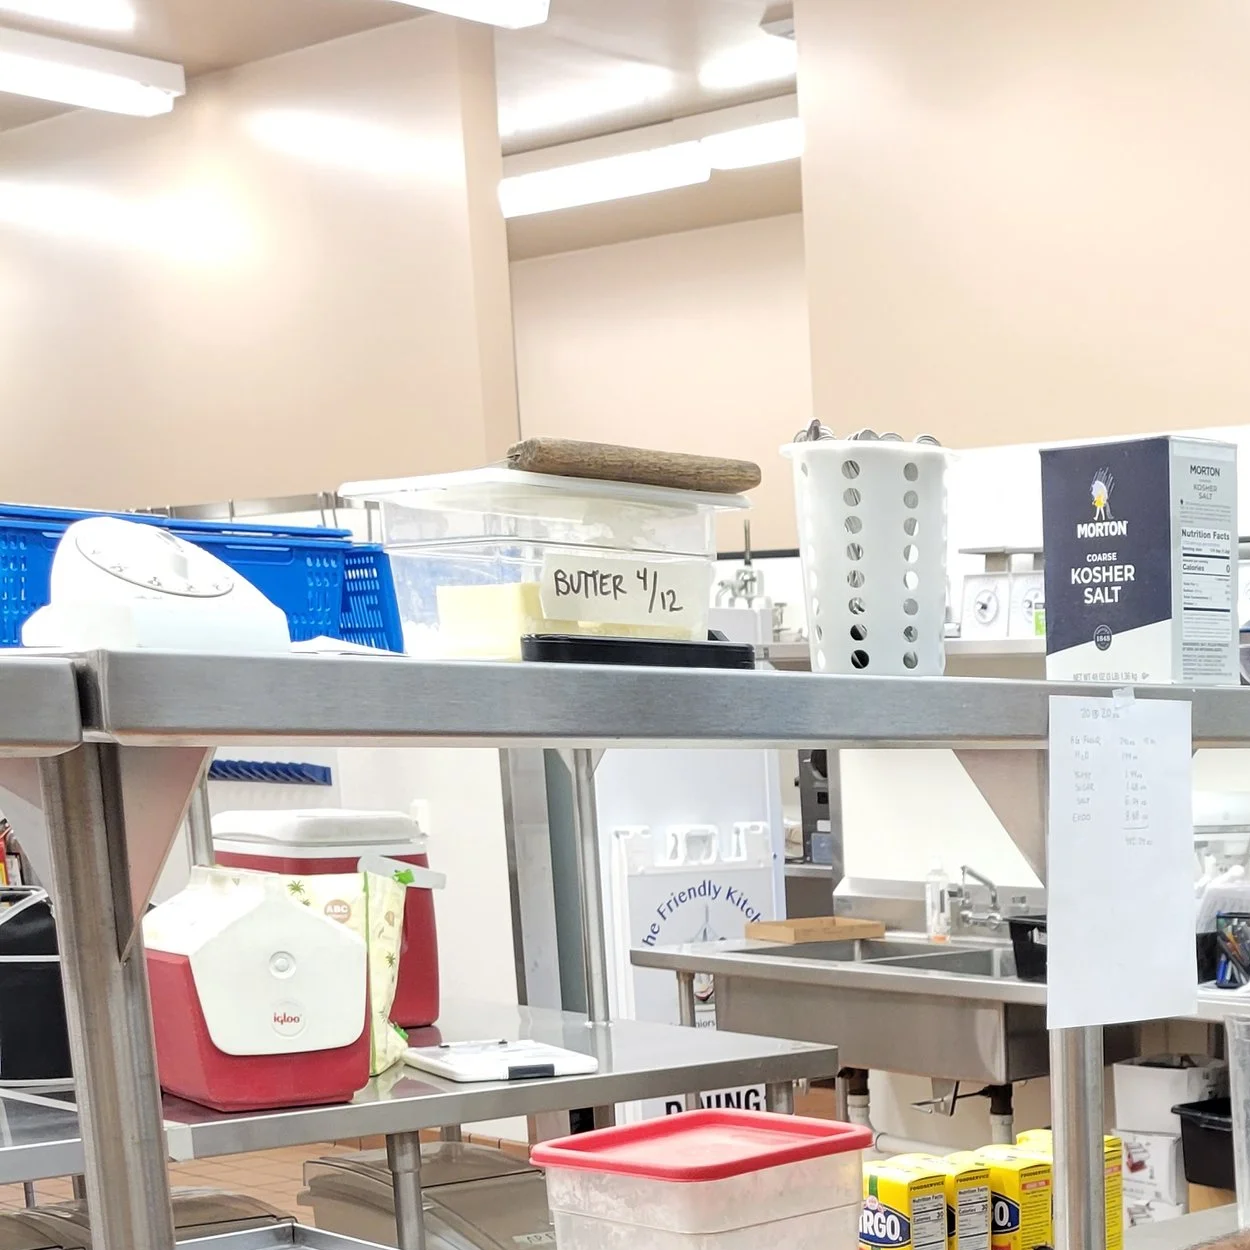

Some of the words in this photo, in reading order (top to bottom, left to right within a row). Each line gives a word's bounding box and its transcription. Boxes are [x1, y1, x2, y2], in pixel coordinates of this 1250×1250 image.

[1189, 465, 1221, 477] MORTON
[1077, 521, 1127, 538] MORTON
[1181, 529, 1211, 539] Nutrition
[1213, 531, 1230, 541] Facts
[1086, 552, 1118, 563] COARSE
[1071, 565, 1135, 585] KOSHER
[554, 568, 627, 600] BUTTER
[636, 567, 684, 613] 4/12
[1084, 586, 1121, 604] SALT
[642, 922, 661, 947] he
[656, 879, 723, 923] Friendly
[273, 1012, 300, 1025] igloo
